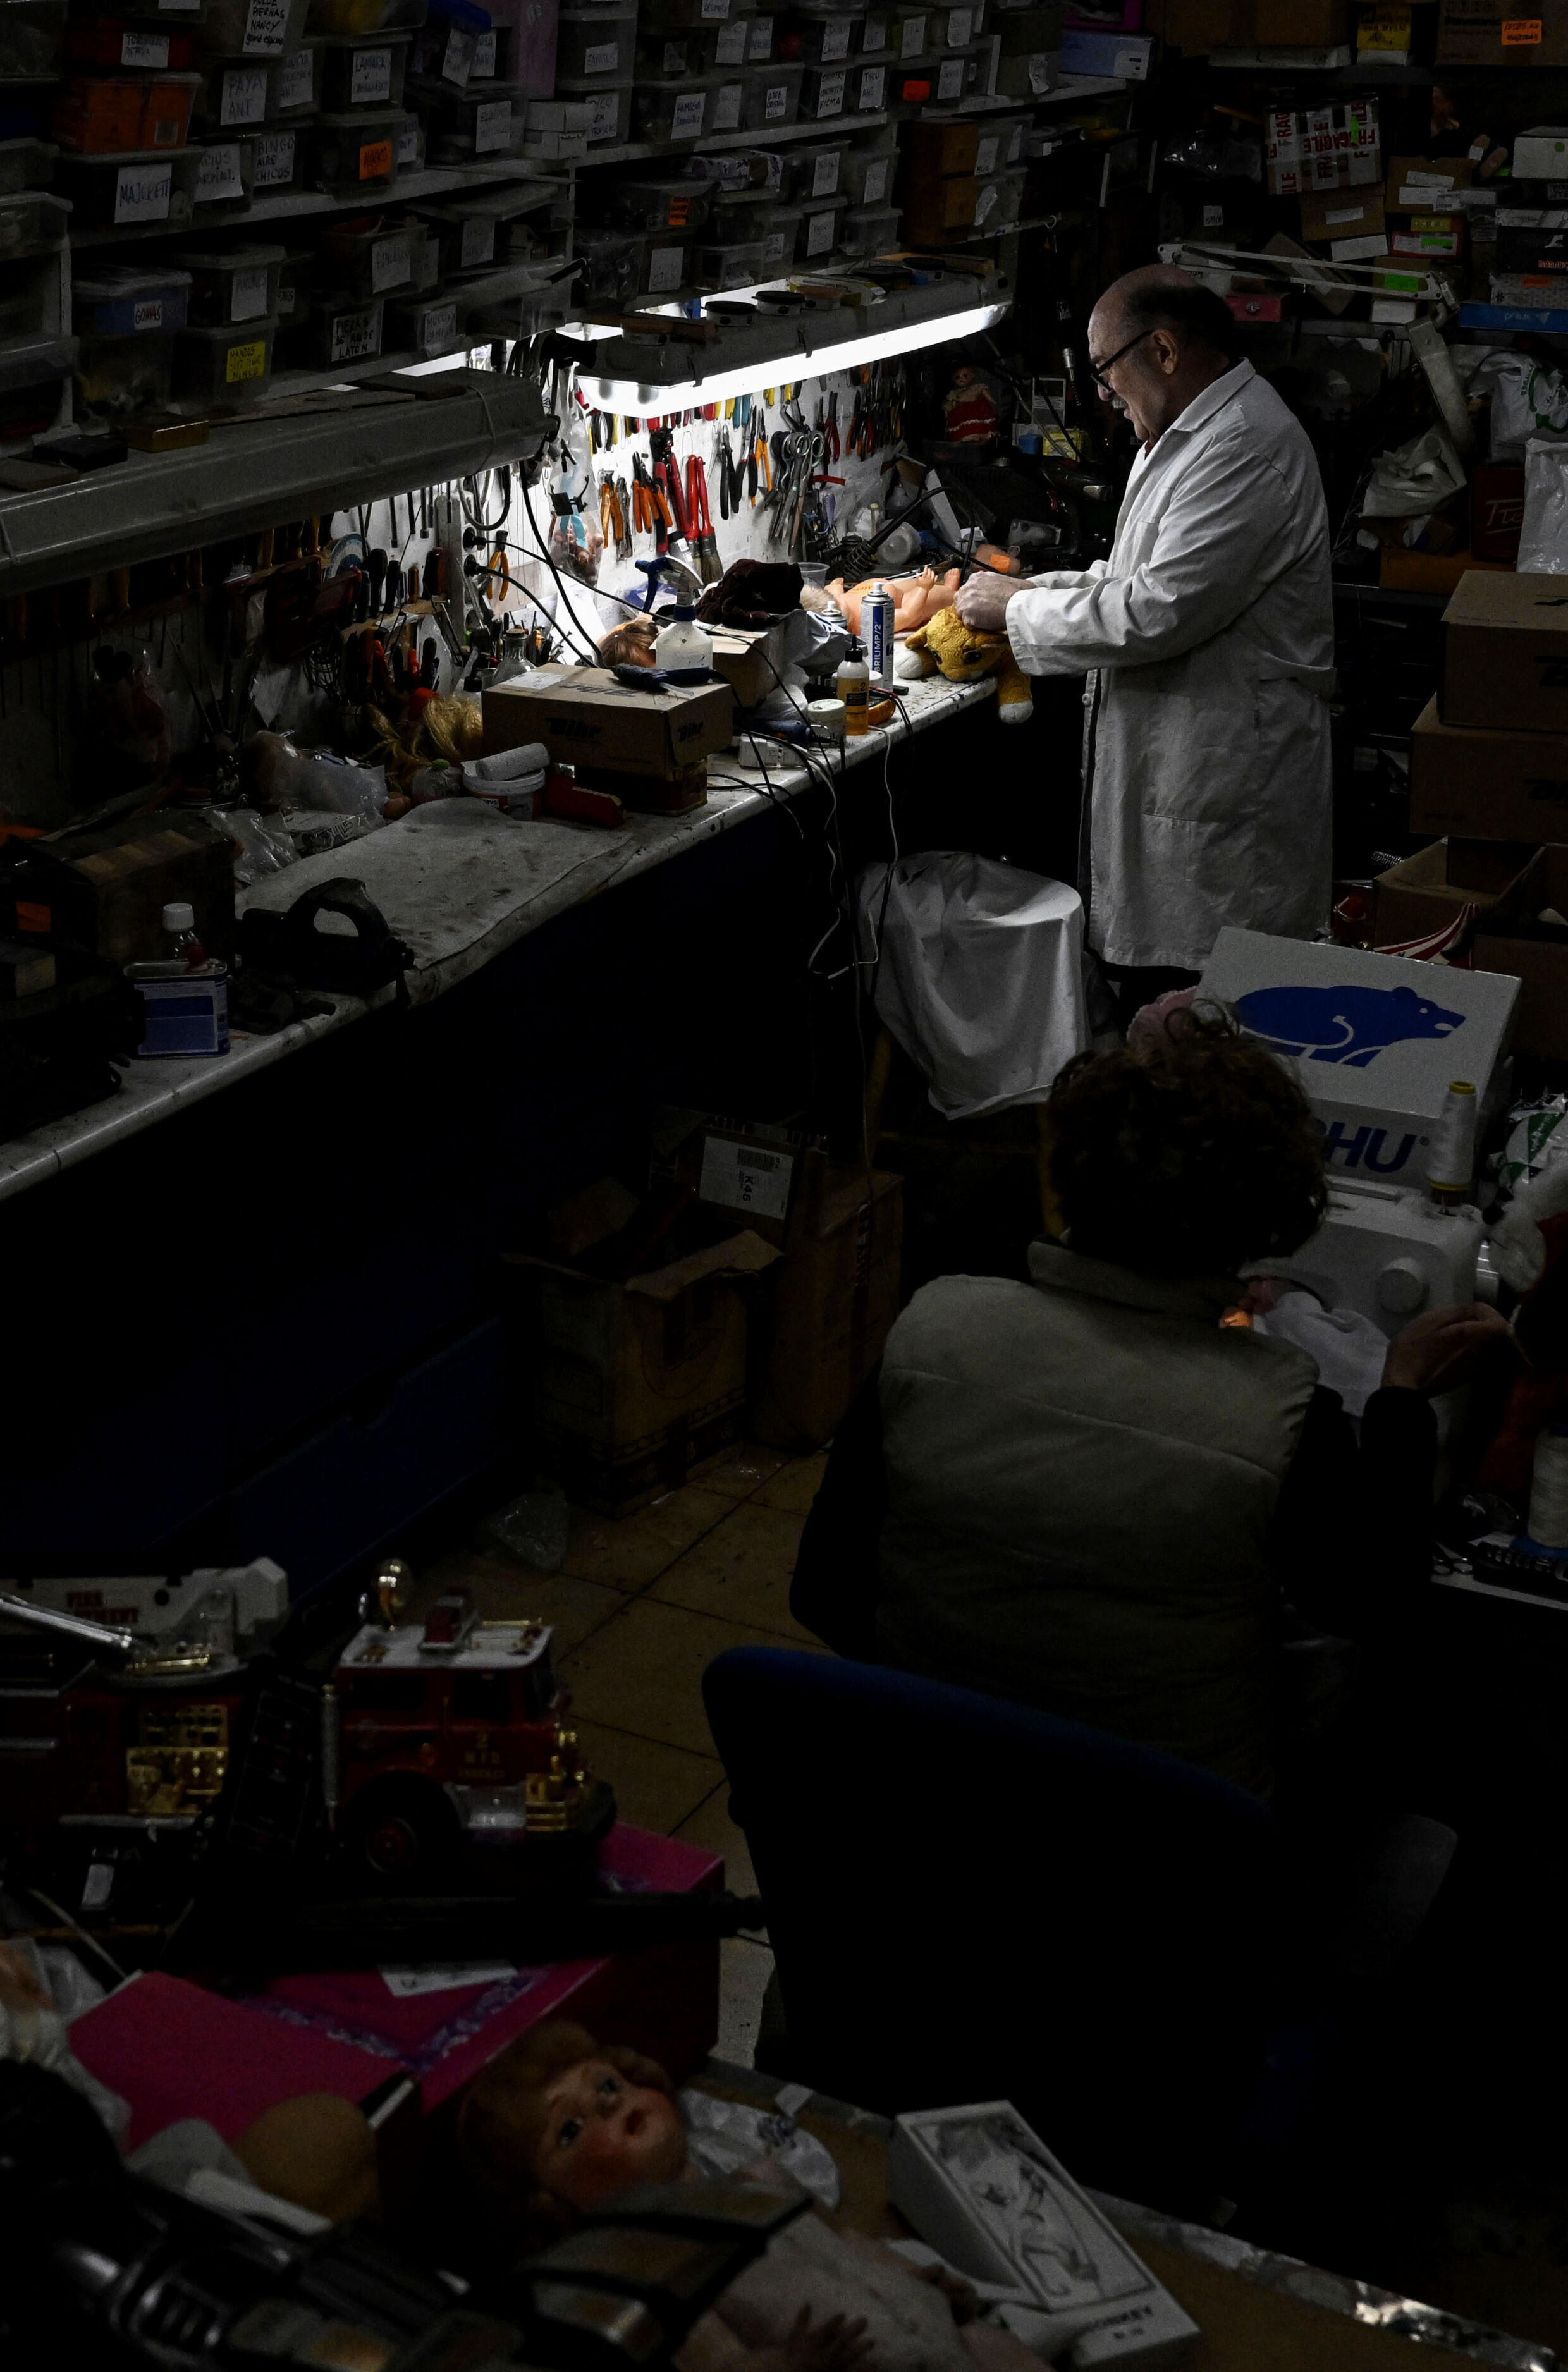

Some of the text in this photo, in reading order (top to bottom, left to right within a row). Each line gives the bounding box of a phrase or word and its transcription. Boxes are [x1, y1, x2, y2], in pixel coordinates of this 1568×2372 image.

[253, 6, 285, 18] PIERNAS
[251, 20, 280, 32] NANCY
[742, 1175, 755, 1202] K46
